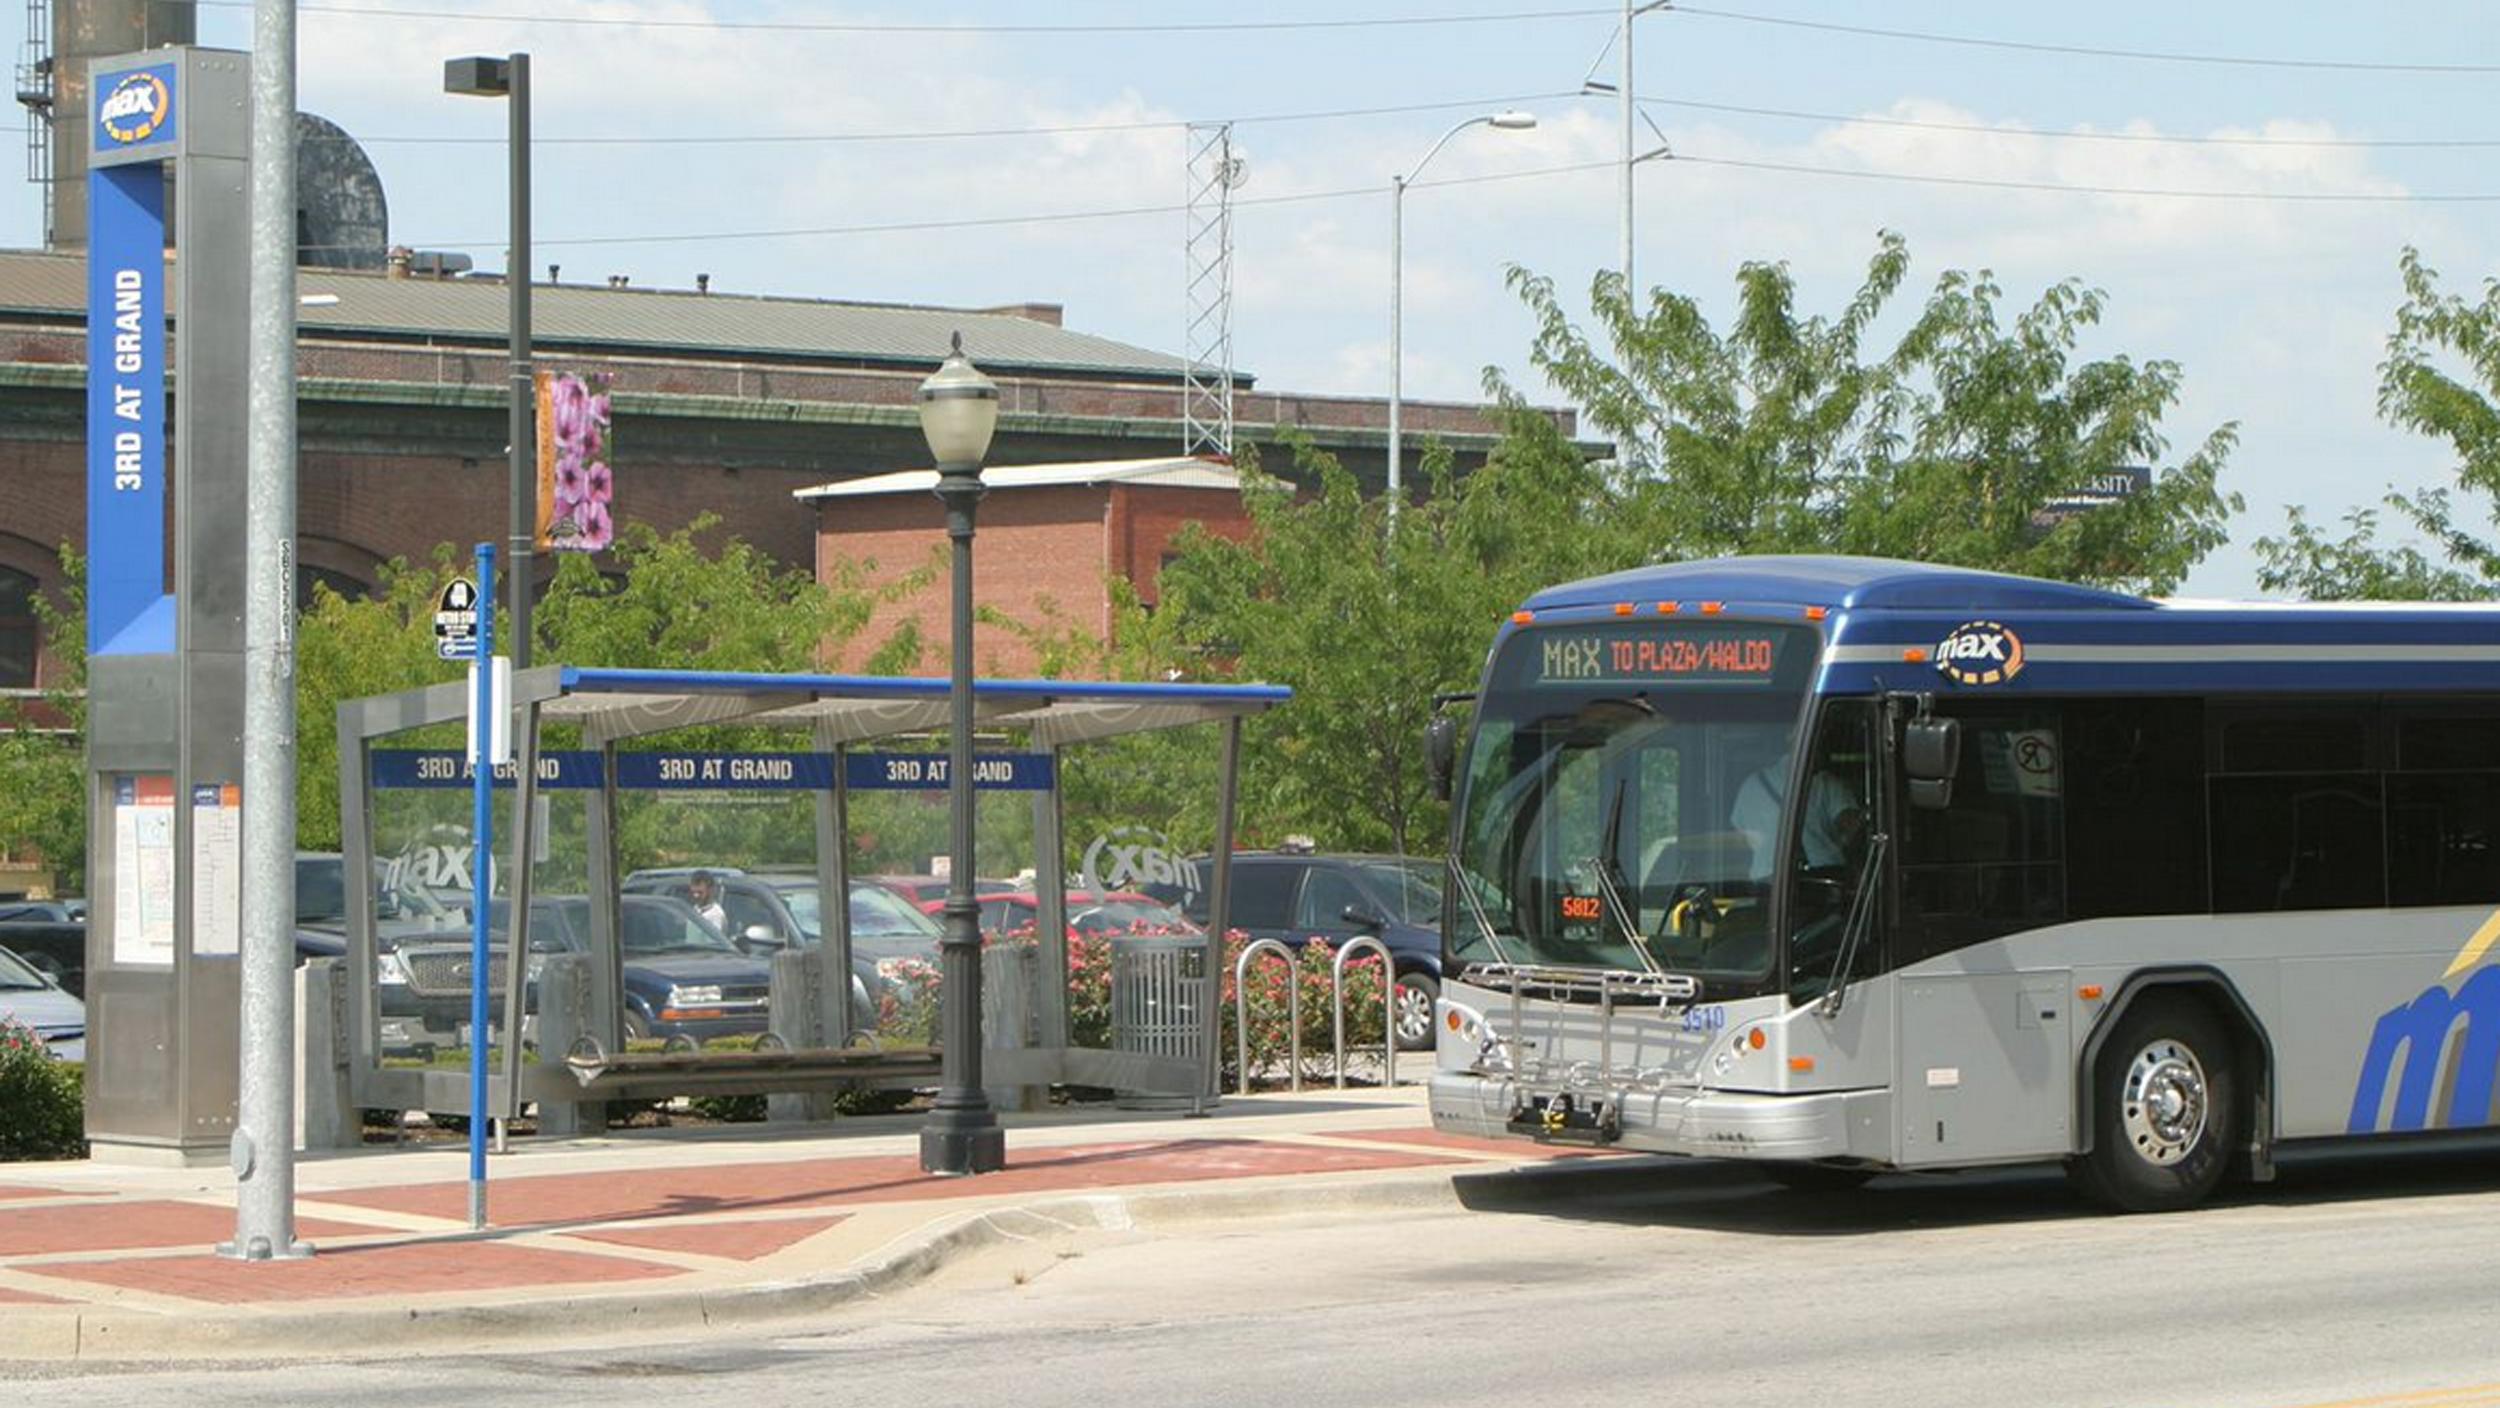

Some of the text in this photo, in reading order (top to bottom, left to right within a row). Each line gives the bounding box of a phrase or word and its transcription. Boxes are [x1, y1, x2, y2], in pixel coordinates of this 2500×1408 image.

[115, 269, 142, 491] 3RD AT GRAND
[1543, 638, 1773, 677] MAX TO PLAZA/WALDO
[416, 758, 455, 779] 3RD
[493, 759, 560, 779] GRND
[659, 758, 793, 781] 3RD AT GRAND
[886, 761, 1013, 782] 3RD AT AND
[1562, 896, 1600, 917] 5812
